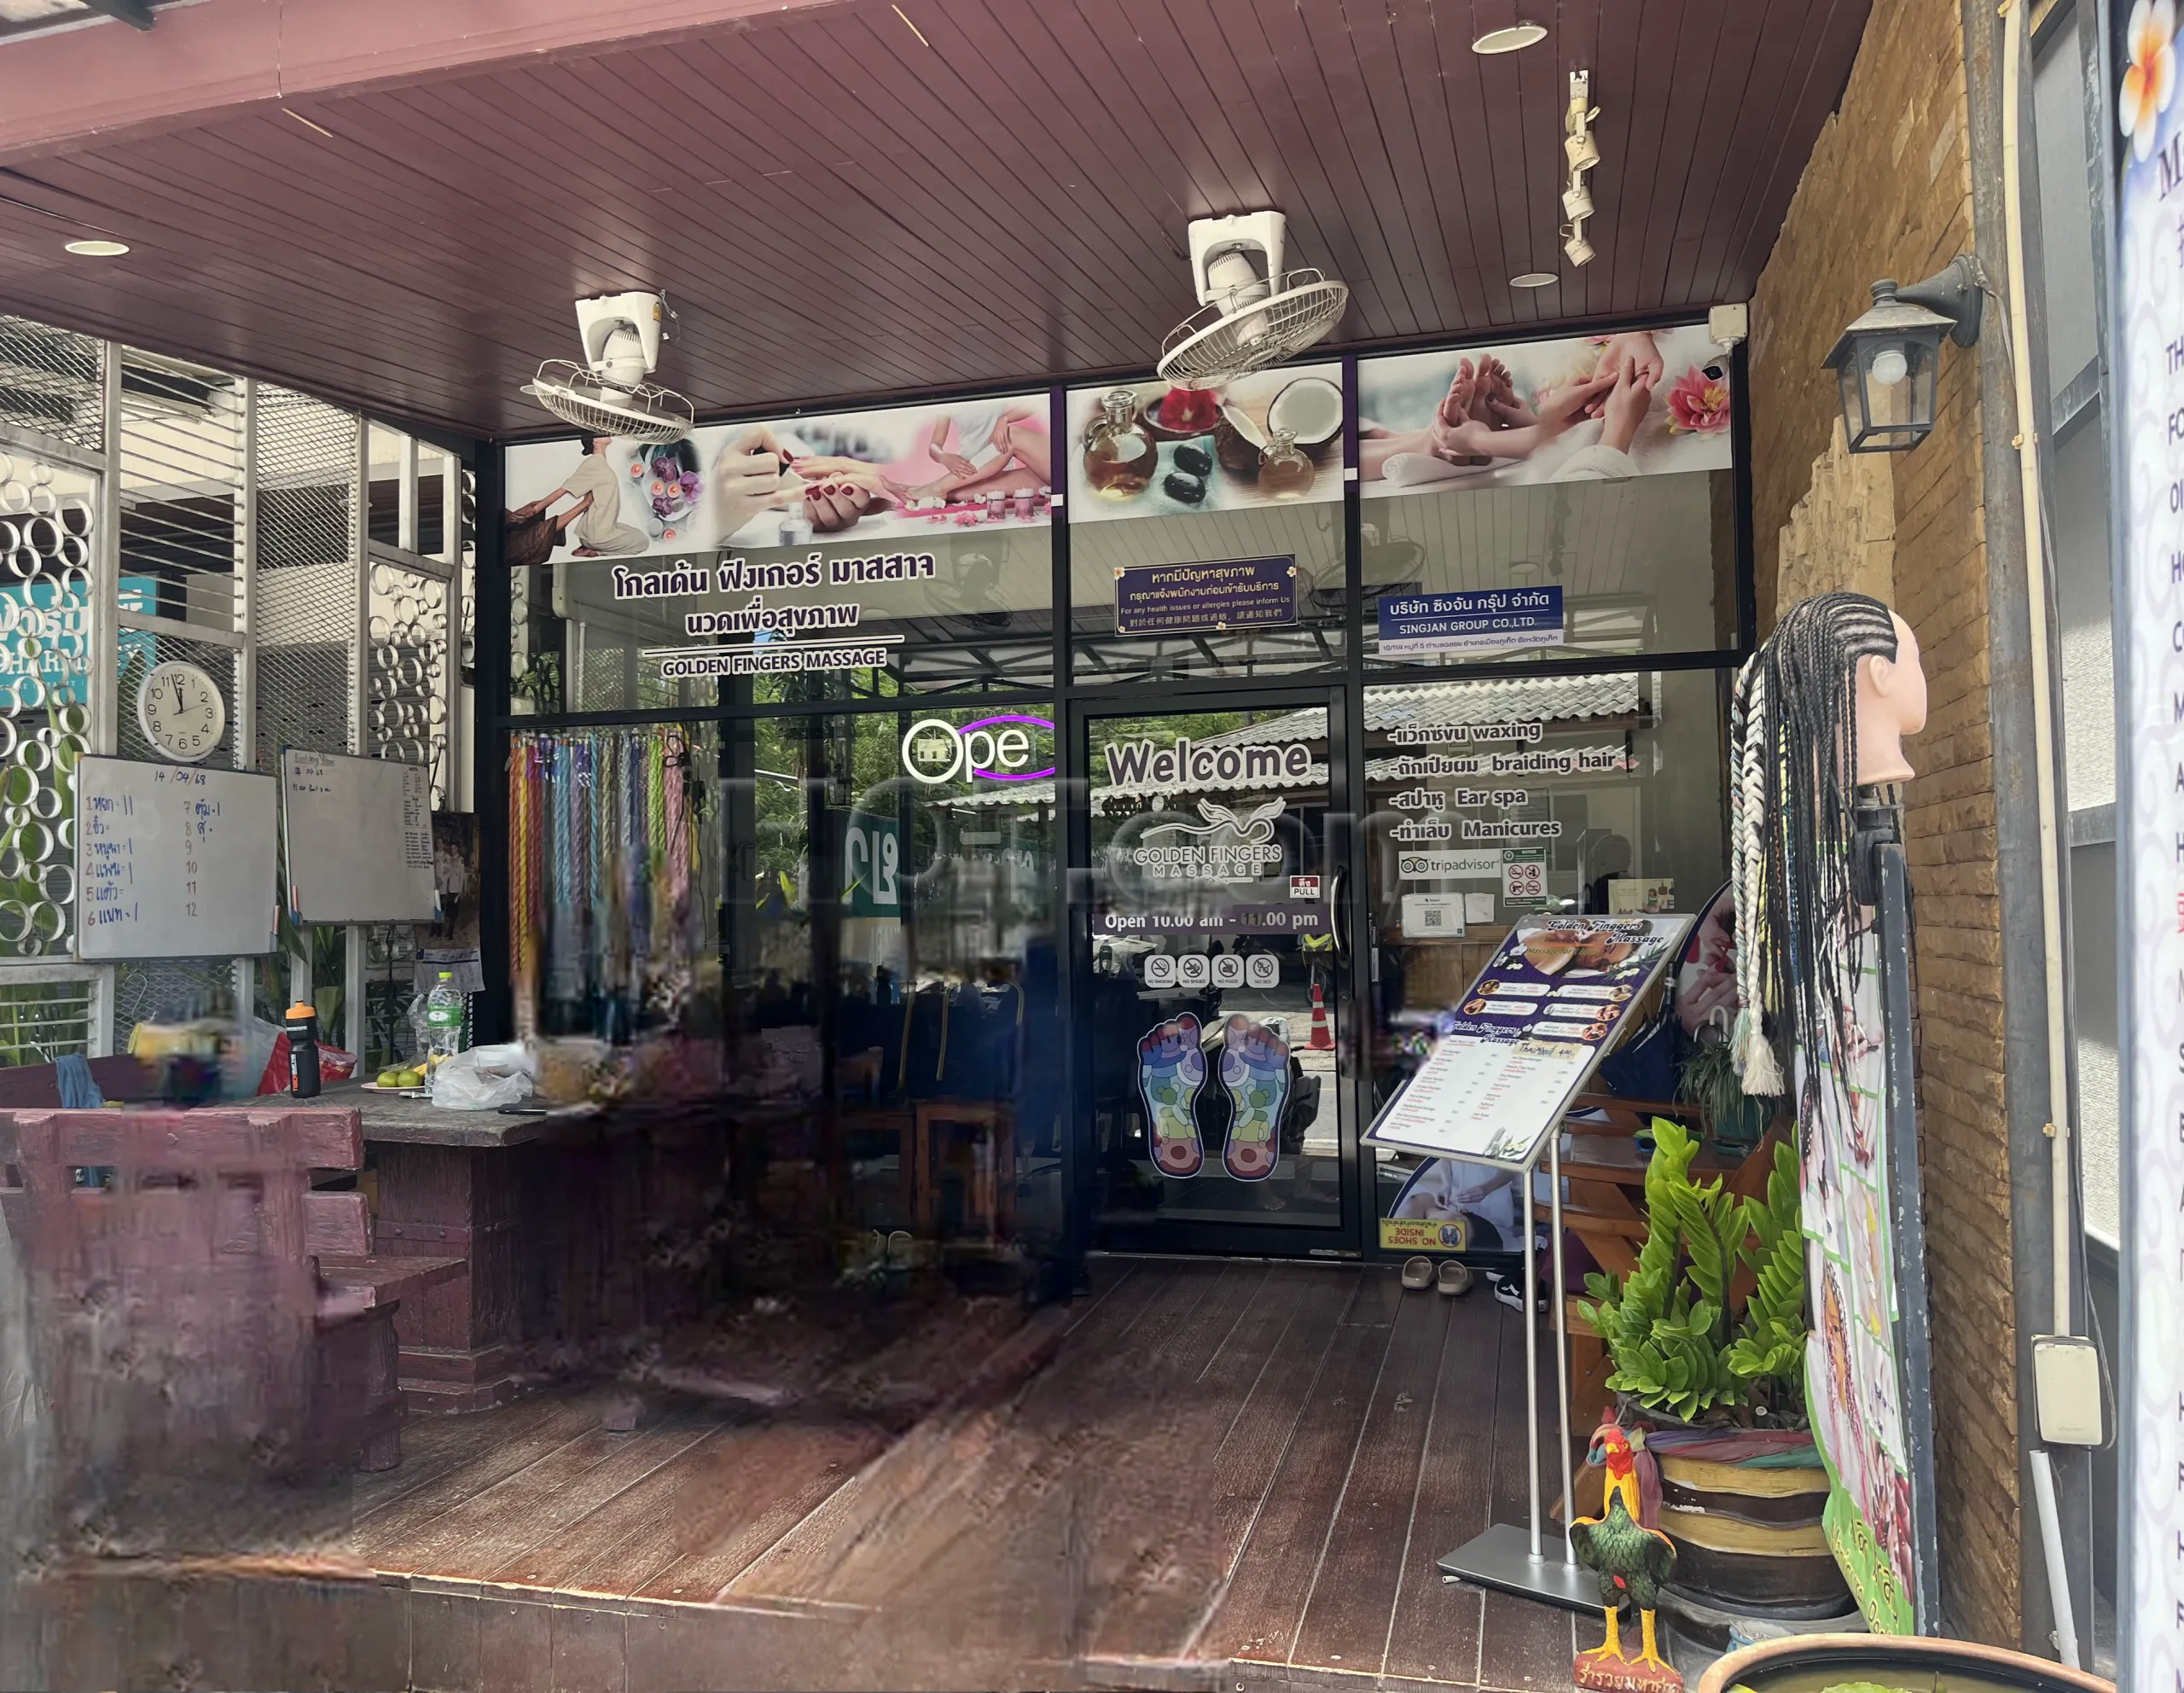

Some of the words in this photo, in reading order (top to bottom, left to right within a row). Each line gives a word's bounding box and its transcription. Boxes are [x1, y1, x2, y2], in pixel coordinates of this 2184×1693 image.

[613, 561, 708, 598] โกลเด้น
[719, 554, 822, 591] ฟิงเกอร์
[832, 554, 935, 584] มาสสาจ
[1153, 566, 1256, 585] หากมีปัญหาสุขภาพ
[1134, 608, 1145, 616] any
[1147, 605, 1168, 614] health
[1202, 601, 1230, 611] allergies
[1232, 599, 1254, 608] please
[1256, 597, 1279, 606] inform
[1390, 599, 1429, 615] บริษัท
[1433, 596, 1472, 613] ซิงจัน
[1478, 593, 1507, 613] กรุ๊ป
[1511, 592, 1549, 608] จำกัด
[688, 598, 858, 636] นวดเพื่อสุขภาพ
[1399, 622, 1447, 635] SINGJAN
[1450, 620, 1489, 631] GROUP
[664, 656, 729, 677] GOLDEN
[734, 653, 800, 673] FINGERS
[806, 649, 886, 668] MASSAGE
[161, 676, 170, 688] 11
[191, 678, 195, 689] 1
[150, 688, 163, 700] 10
[200, 691, 208, 703] 2
[147, 704, 157, 715] 9
[205, 707, 214, 719] 3
[153, 720, 161, 732] 8
[200, 724, 210, 734] 4
[1472, 723, 1542, 742] waxing
[165, 734, 173, 746] 7
[178, 738, 187, 749] 6
[192, 735, 200, 747] 5
[1107, 739, 1310, 788] Welcome
[1492, 755, 1571, 773] braiding
[1578, 753, 1617, 768] hair
[1457, 790, 1487, 806] Ear
[1494, 790, 1526, 809] spa
[1463, 819, 1560, 837] Manicures
[1135, 846, 1205, 866] GOLDEN
[1209, 844, 1282, 864] FINGERS
[186, 861, 198, 874] 10
[1153, 864, 1263, 878] MASSAGE
[1430, 858, 1496, 874] tripadvisor
[186, 881, 197, 895] 11
[1293, 887, 1316, 897] PULL
[185, 901, 198, 917] 12
[1104, 915, 1147, 932] Open
[1153, 915, 1194, 928] 10.00
[1199, 915, 1224, 928] am
[1240, 911, 1287, 928] 11.00
[1292, 912, 1319, 930] pm
[1548, 920, 1585, 932] Golden
[1587, 920, 1643, 933] Finggers
[1605, 933, 1664, 945] Massage
[1395, 1228, 1425, 1236] INSIDE
[1387, 1236, 1418, 1245] SHOES
[1421, 1237, 1437, 1246] NO
